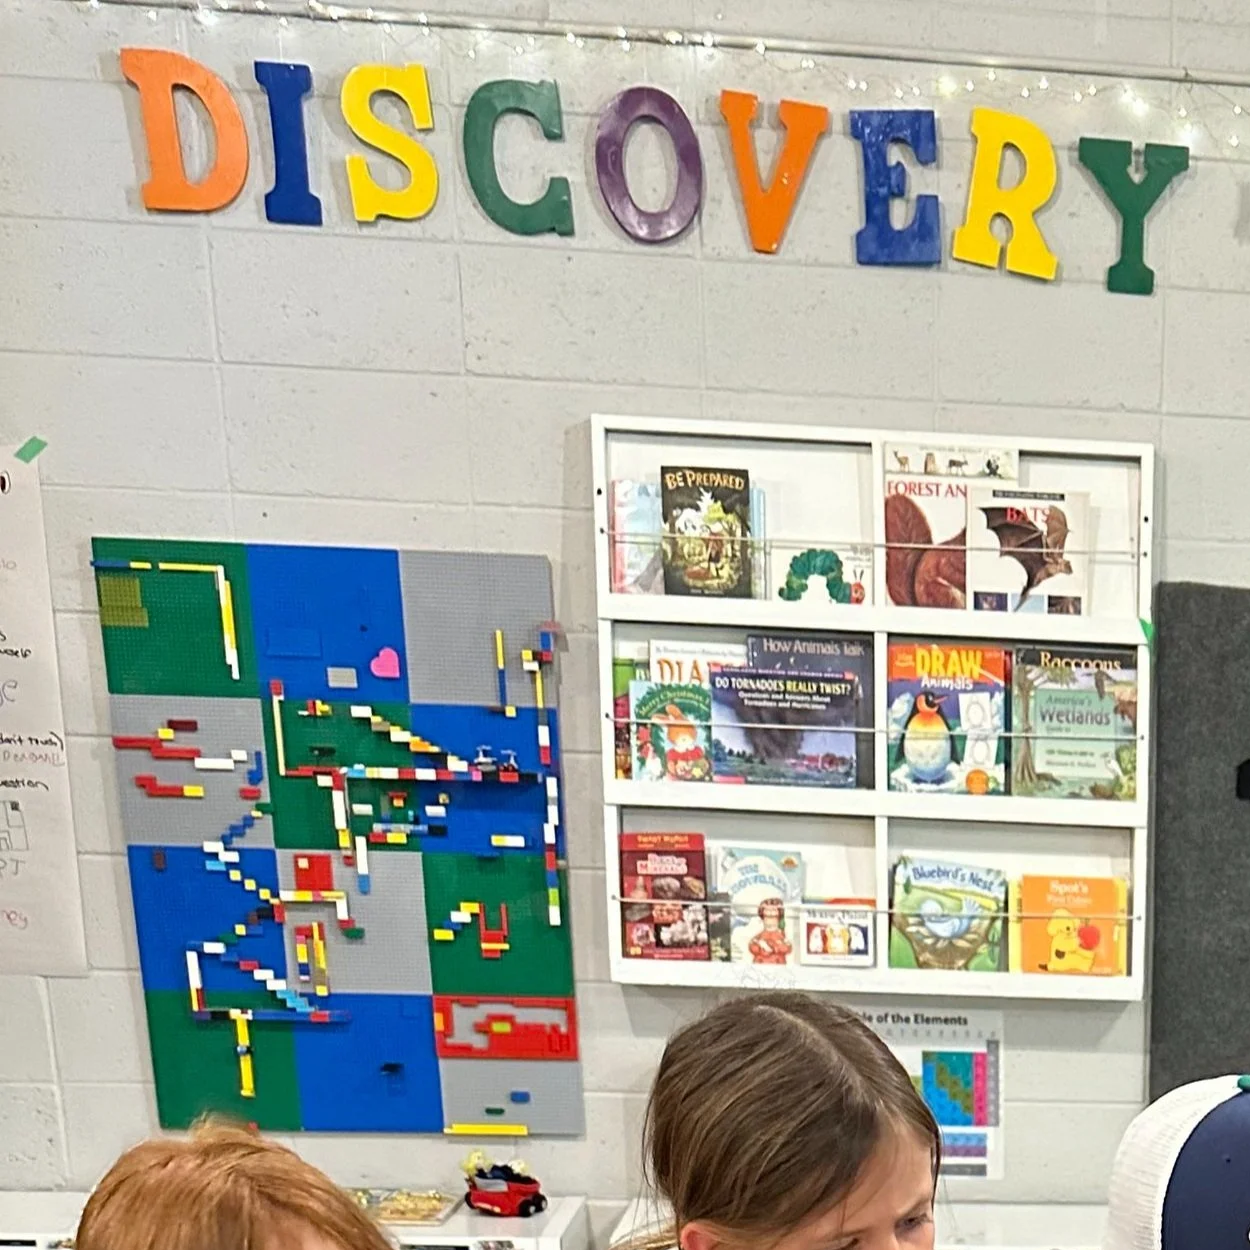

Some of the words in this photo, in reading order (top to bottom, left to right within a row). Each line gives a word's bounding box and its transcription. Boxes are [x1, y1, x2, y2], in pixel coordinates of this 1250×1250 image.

[120, 48, 1190, 295] DISCOVERY
[665, 472, 684, 490] BE
[684, 469, 746, 491] PREPARED
[887, 480, 942, 498] FOREST
[1006, 506, 1050, 523] BATS
[763, 638, 791, 653] How
[793, 639, 841, 656] Animals
[916, 648, 983, 680] DRAW
[1040, 651, 1121, 672] Raccoons
[715, 677, 730, 689] DO
[730, 677, 785, 691] TORNADOES
[785, 681, 817, 693] REALLY
[818, 682, 851, 696] TWIST?
[771, 692, 784, 700] and
[1039, 705, 1111, 726] Wetlands
[911, 866, 966, 883] Bluebird's
[969, 872, 995, 892] Nest
[891, 1013, 911, 1024] the
[913, 1013, 968, 1026] Elements
